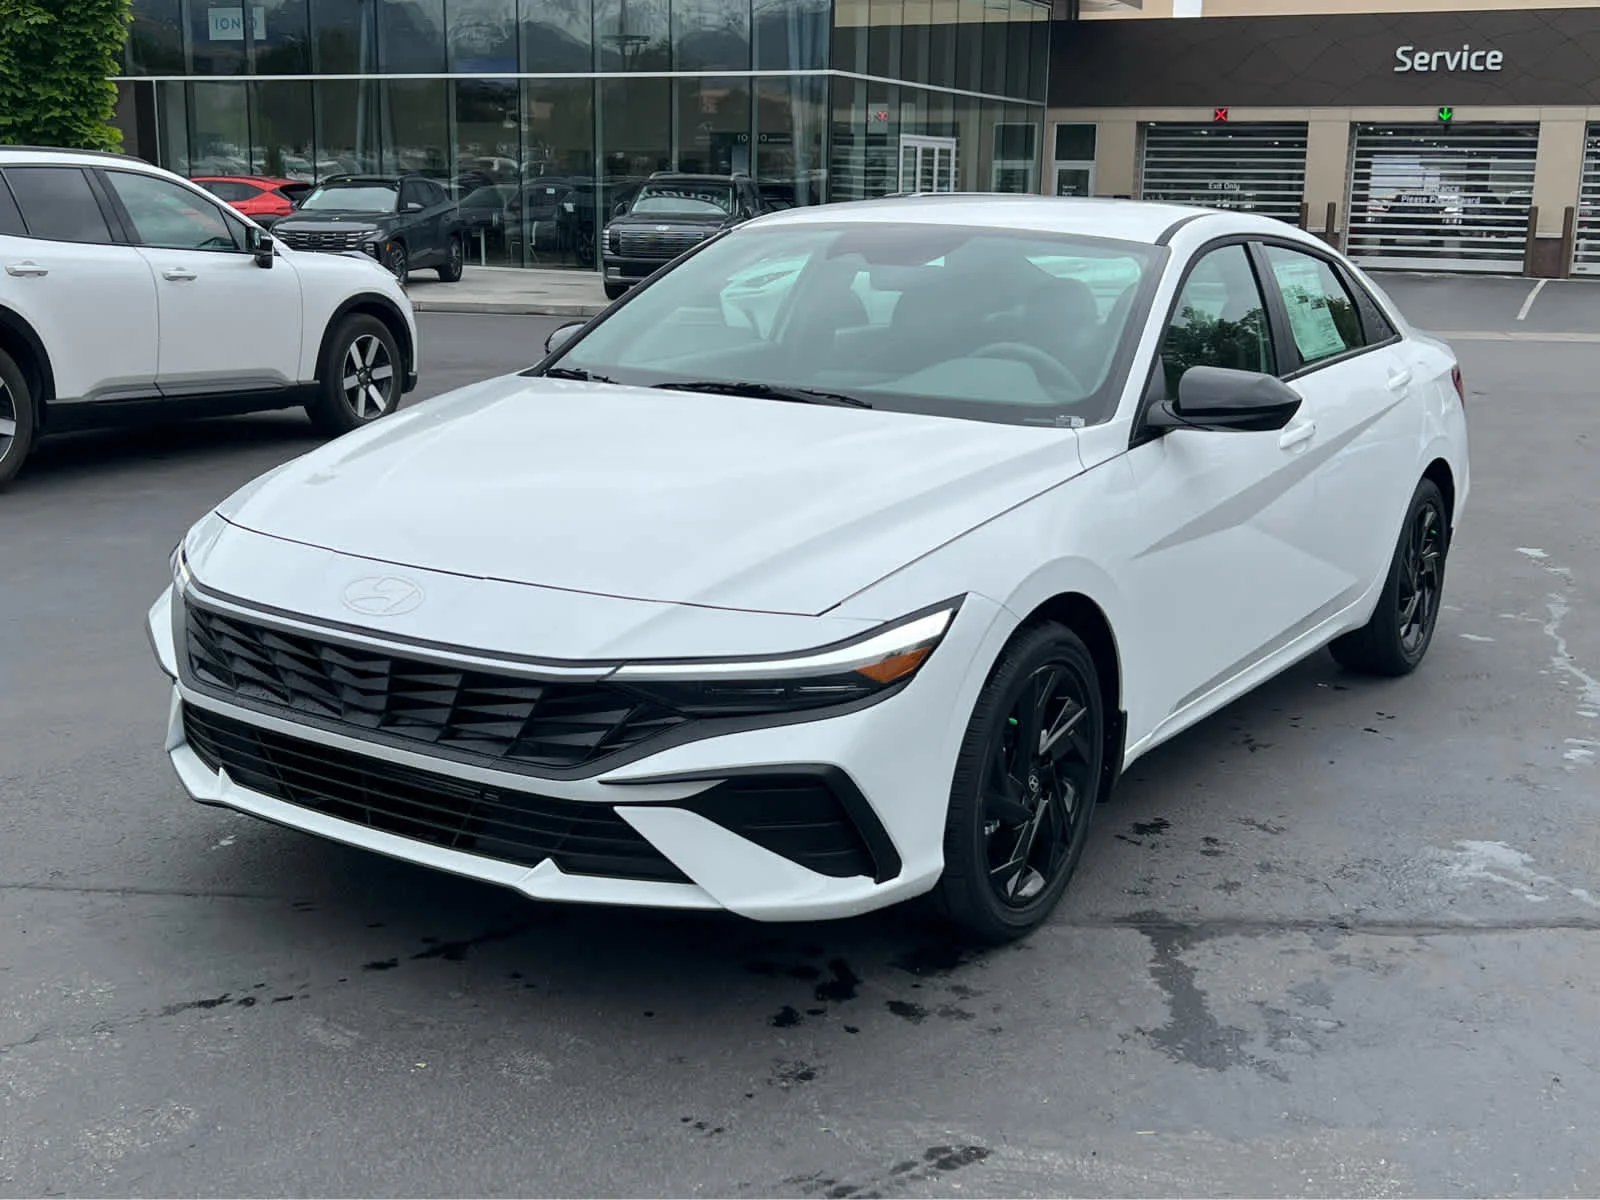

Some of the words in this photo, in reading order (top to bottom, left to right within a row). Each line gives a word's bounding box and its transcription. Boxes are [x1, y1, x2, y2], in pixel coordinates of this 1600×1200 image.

[1393, 44, 1504, 72] Service
[1208, 181, 1222, 189] Exit
[1223, 182, 1241, 192] Only
